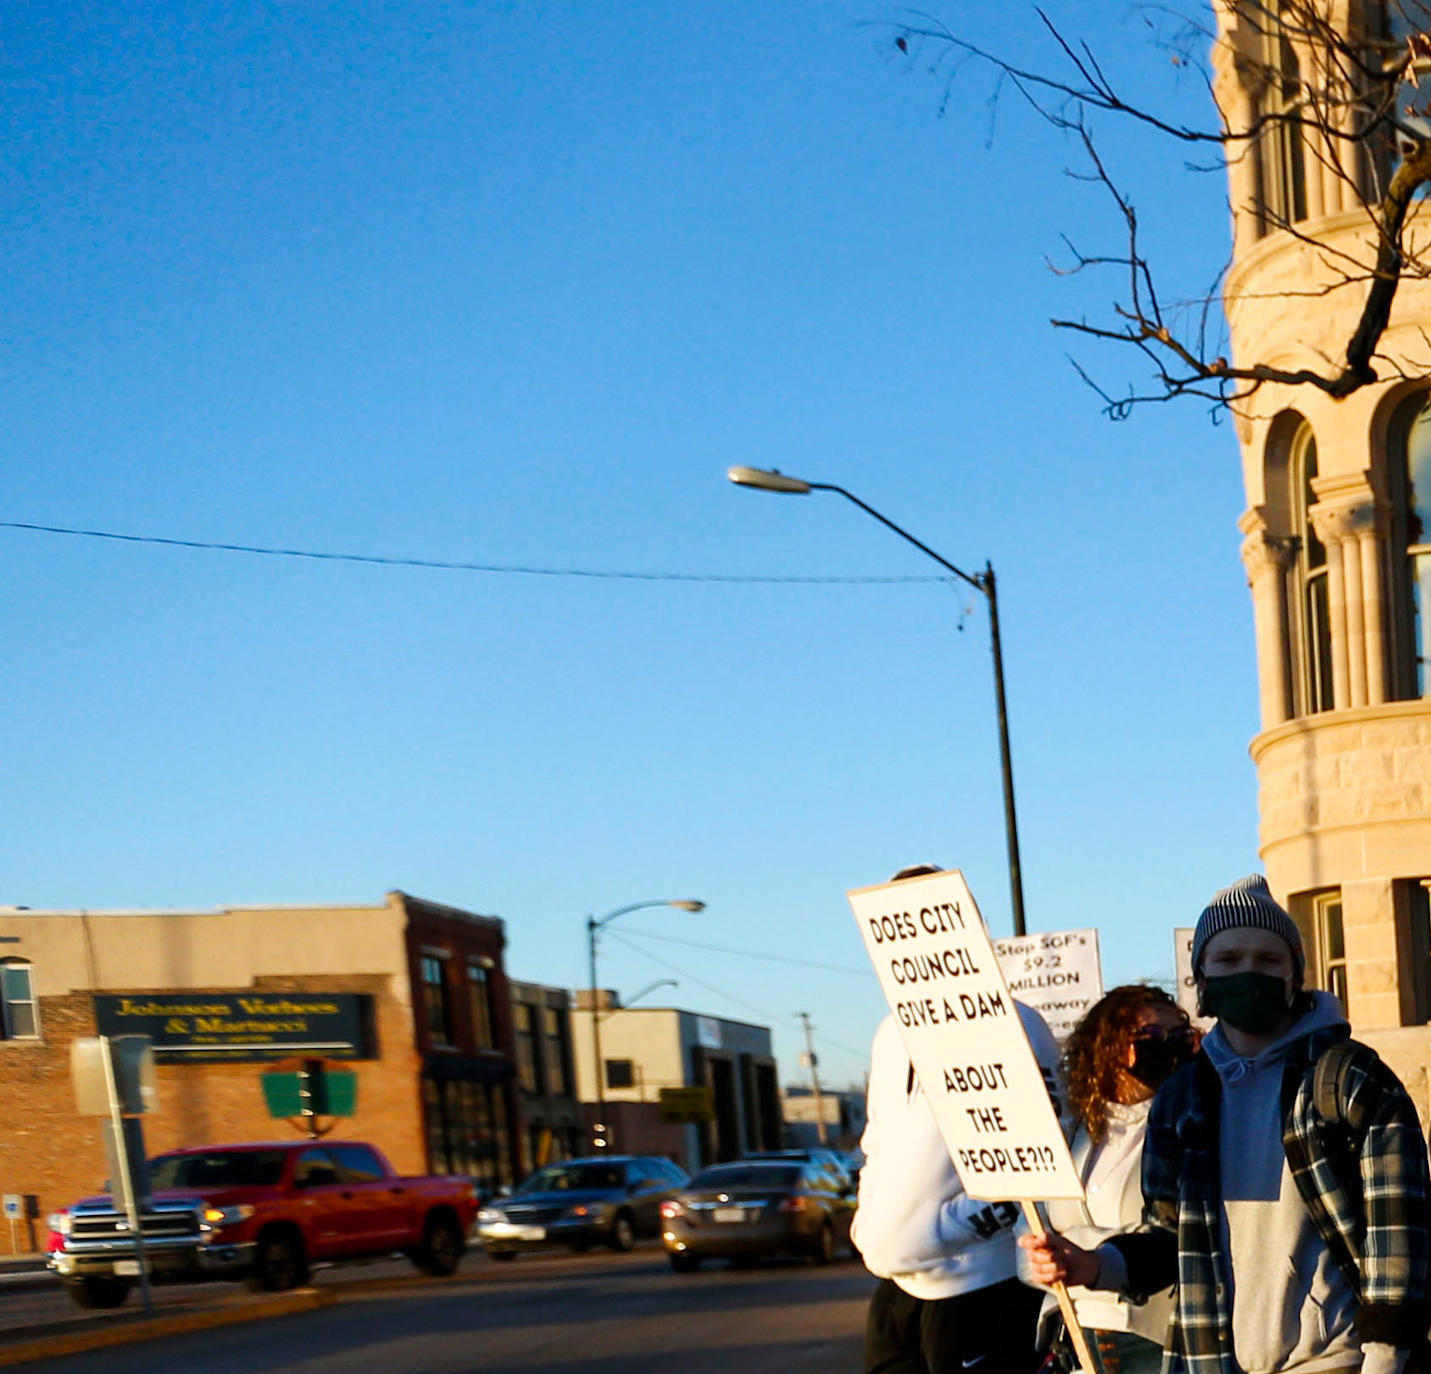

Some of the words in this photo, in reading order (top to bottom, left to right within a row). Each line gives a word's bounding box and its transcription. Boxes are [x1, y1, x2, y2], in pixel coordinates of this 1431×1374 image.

[869, 911, 918, 944] DOES
[920, 901, 966, 935] CITY
[997, 943, 1036, 957] Stop
[1040, 934, 1087, 949] SGF's
[891, 948, 980, 985] COUNCIL
[1024, 955, 1063, 972] $9.2
[1010, 972, 1079, 991] MILLION
[897, 999, 940, 1028] GIVE
[943, 997, 959, 1023] A
[959, 990, 1007, 1021] DAM
[943, 1063, 1008, 1094] ABOUT
[966, 1107, 1008, 1133] THE
[958, 1146, 1057, 1173] PEOPLE?!?
